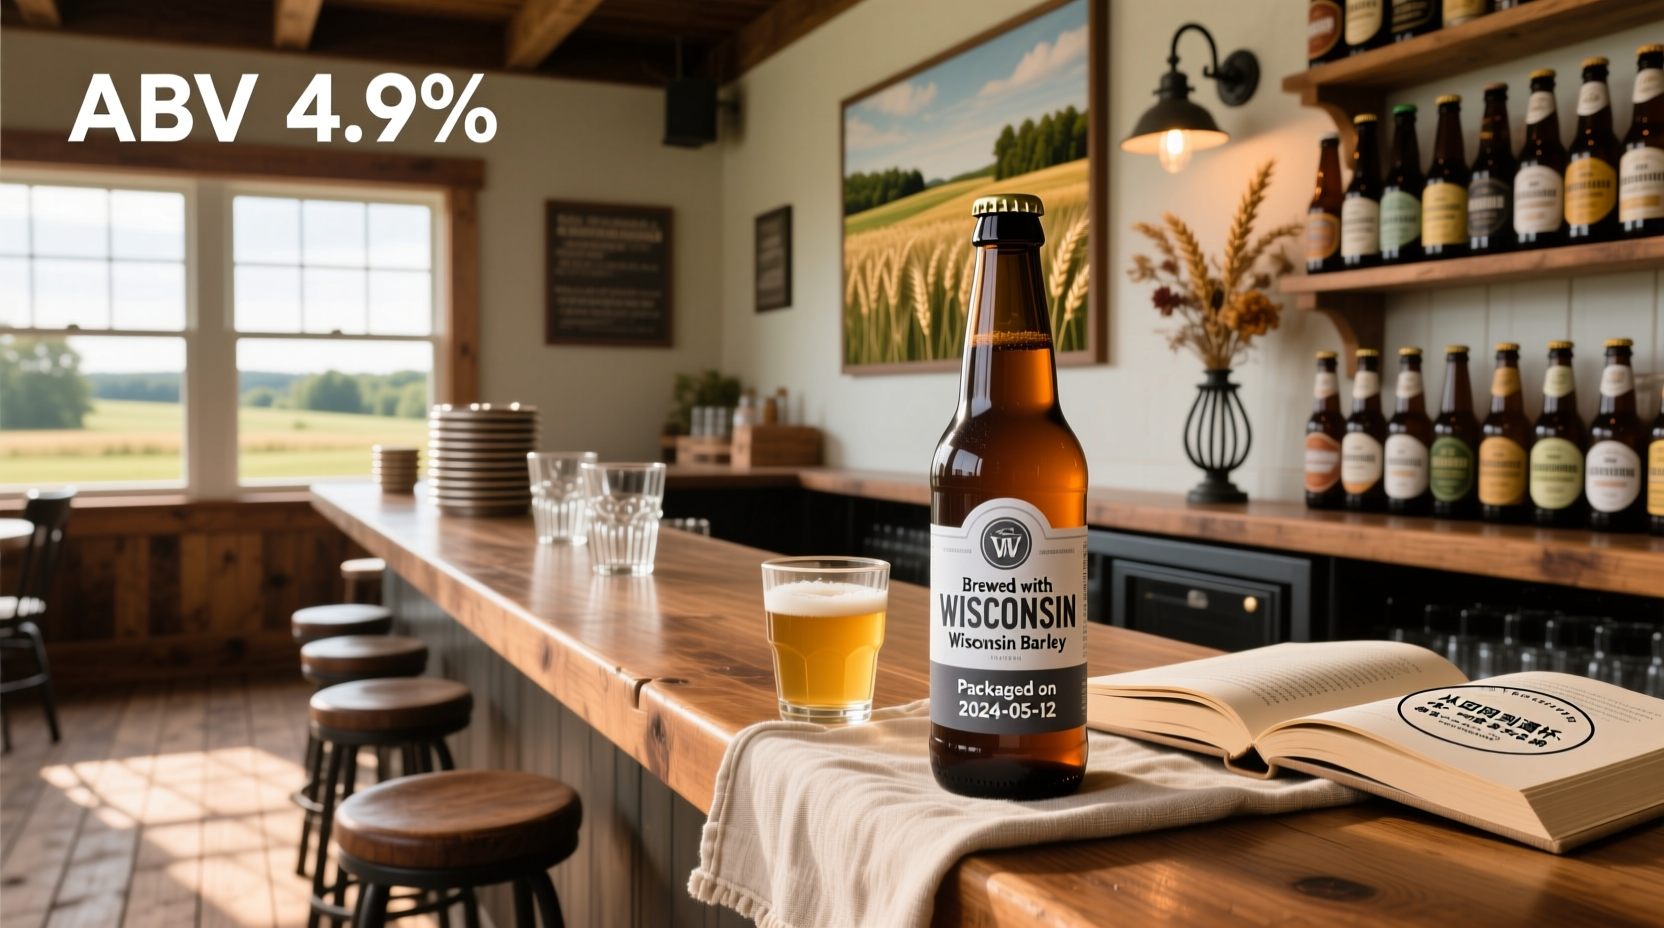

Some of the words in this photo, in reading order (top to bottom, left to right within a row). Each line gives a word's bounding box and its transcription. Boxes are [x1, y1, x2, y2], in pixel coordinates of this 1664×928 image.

[962, 576, 1017, 593] Brewed
[1020, 576, 1053, 593] with
[940, 593, 1076, 630] WISCONSIN
[1020, 633, 1067, 654] Barley
[957, 678, 1034, 701] Packaged
[1038, 683, 1057, 696] on
[958, 700, 1057, 720] 2024-05-12
